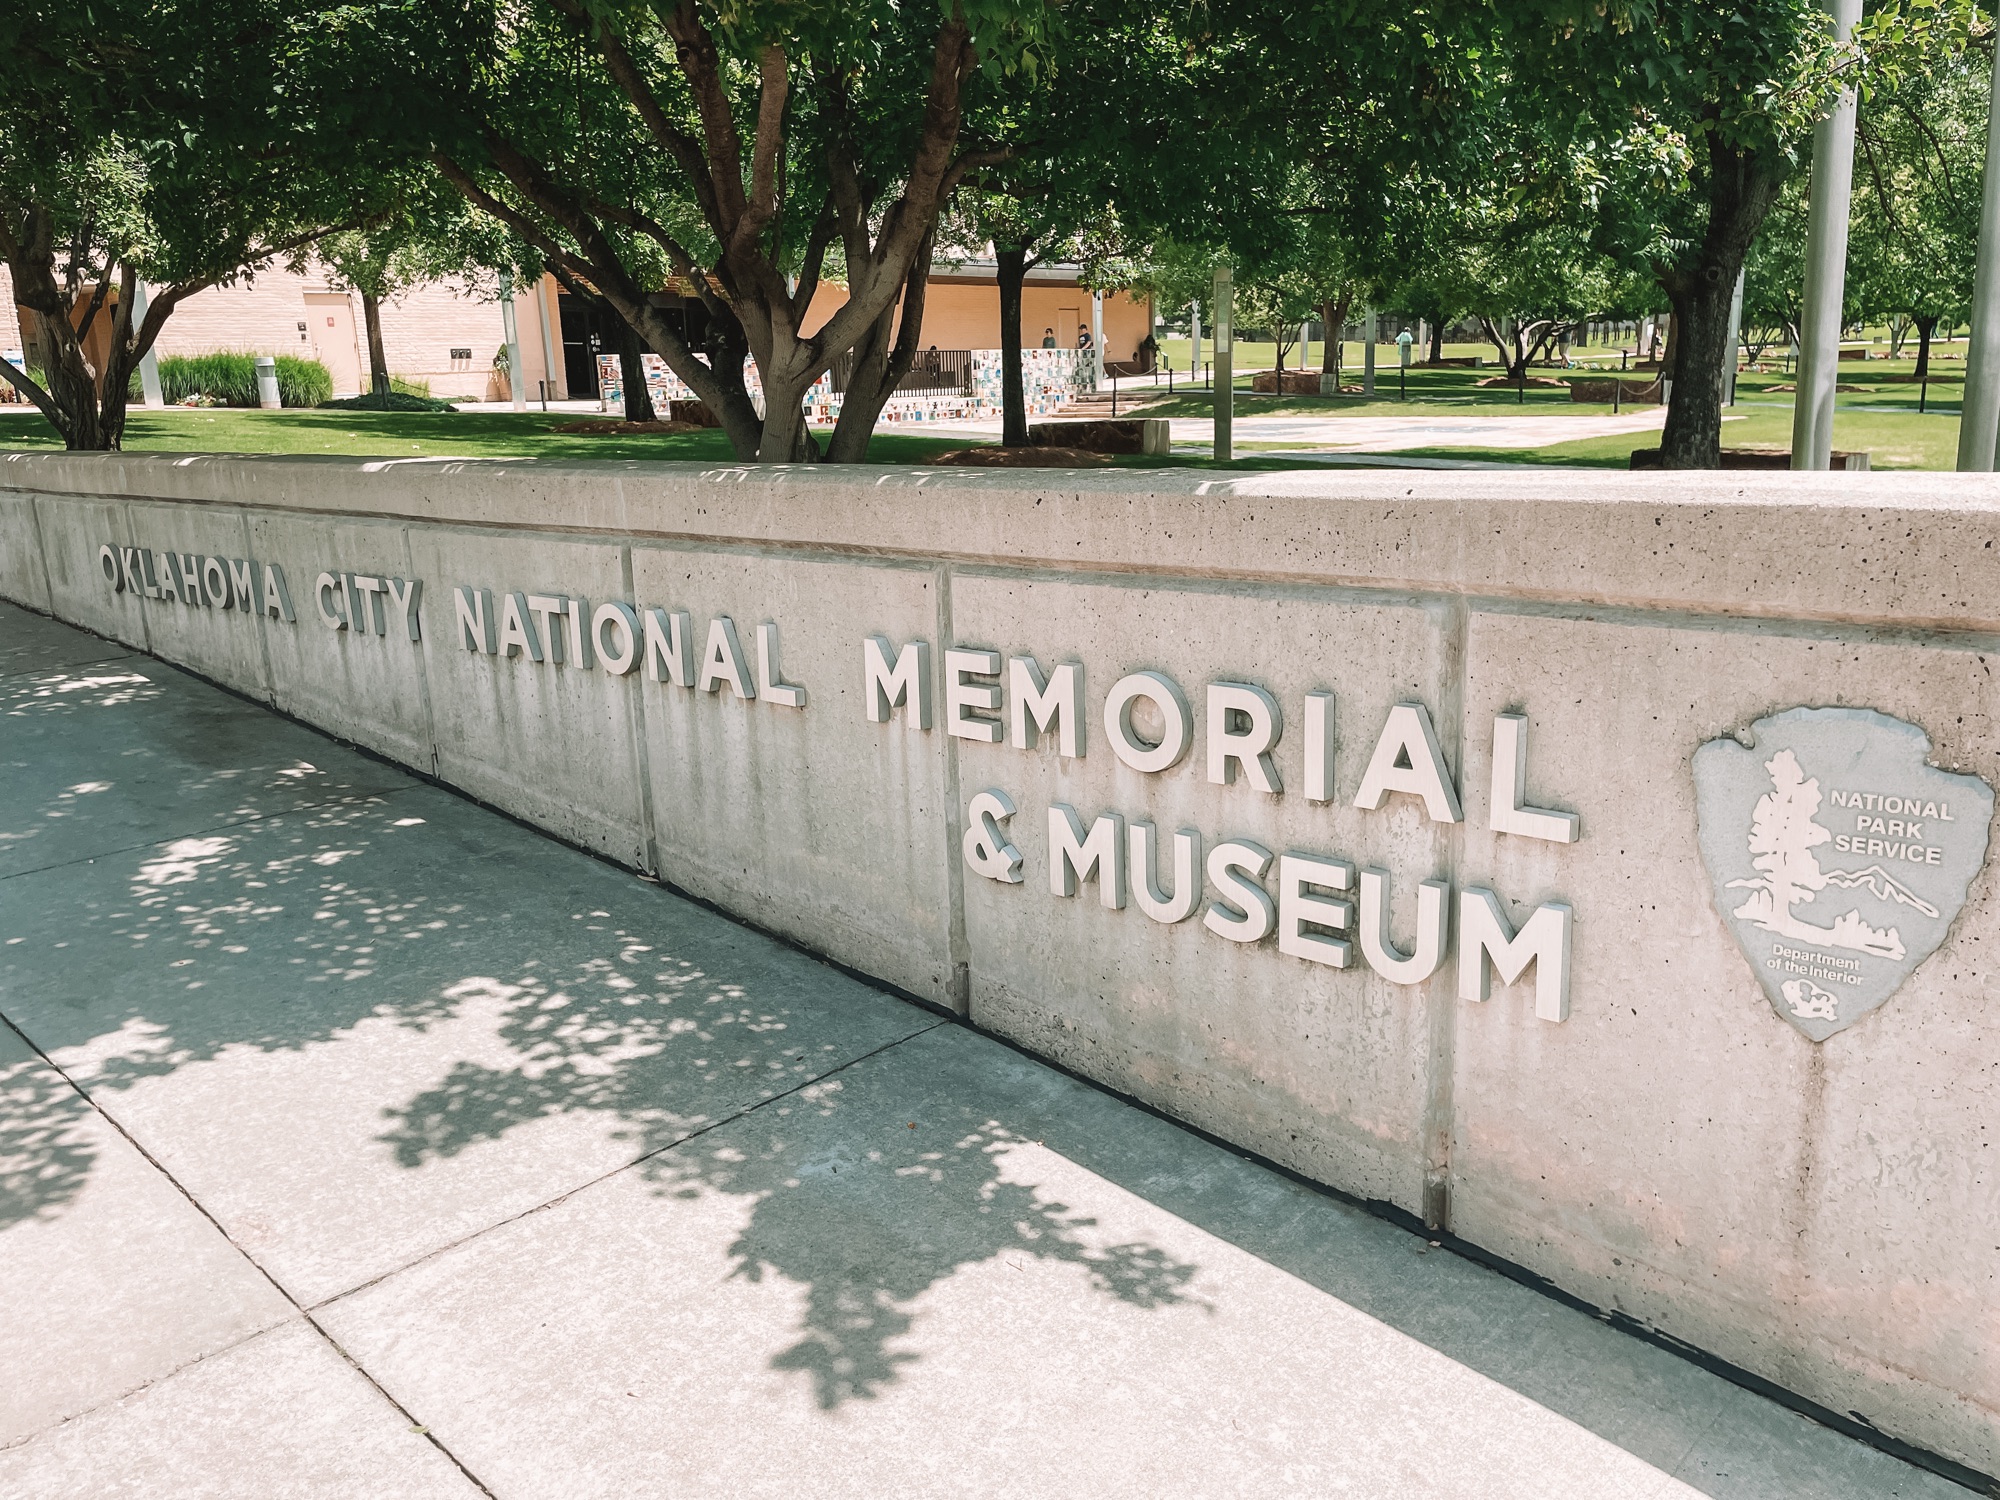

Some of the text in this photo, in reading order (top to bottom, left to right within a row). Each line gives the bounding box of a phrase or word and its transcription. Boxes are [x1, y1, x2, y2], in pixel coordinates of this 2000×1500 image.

[100, 543, 1580, 843] OKLAHOMA CITY NATIONAL MEMORIAL
[1831, 791, 1954, 820] NATIONAL
[1857, 816, 1923, 839] PARK
[1835, 836, 1941, 864] SERVICE
[963, 787, 1574, 1024] & MUSEUM
[1773, 944, 1860, 970] Department
[1767, 958, 1864, 985] of the Interior
